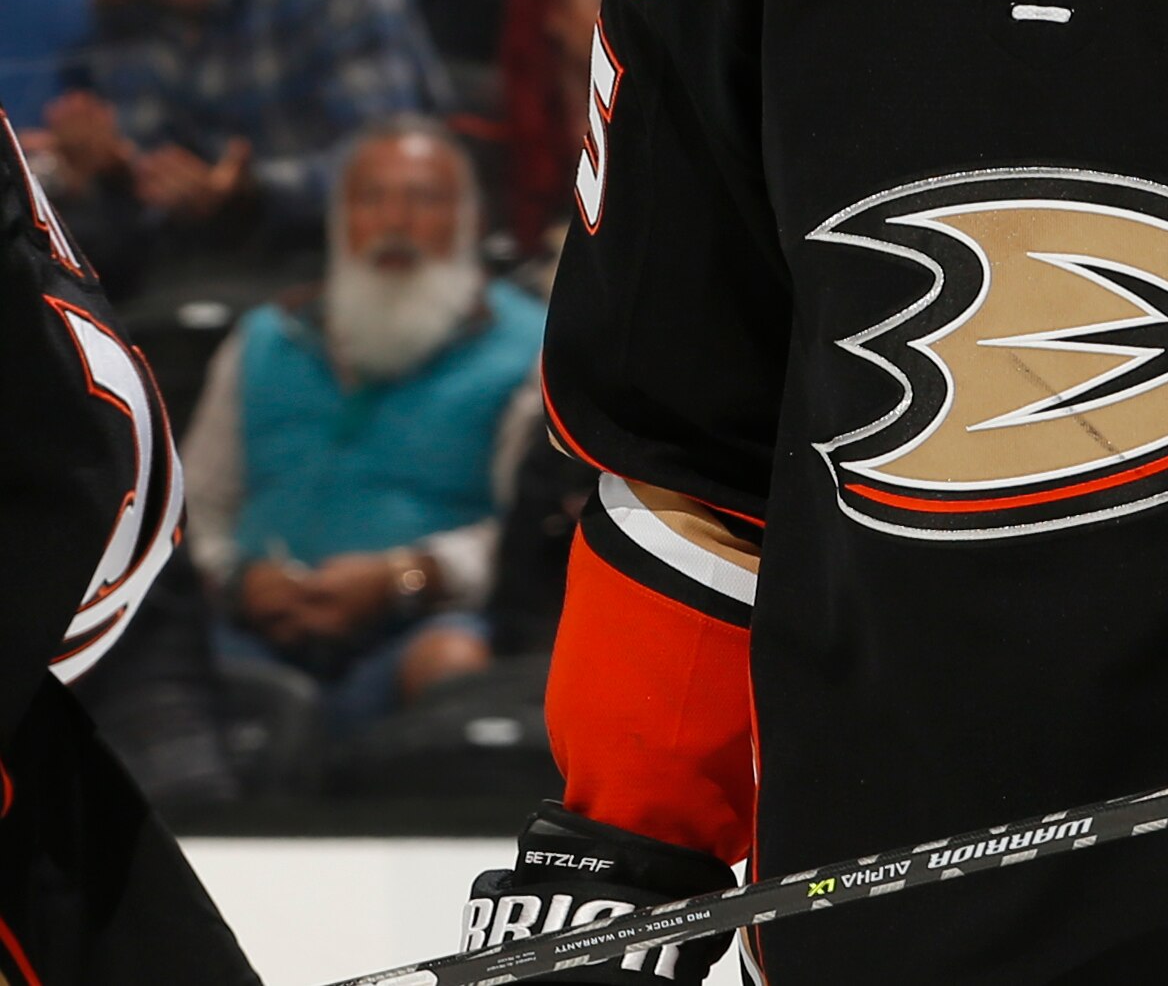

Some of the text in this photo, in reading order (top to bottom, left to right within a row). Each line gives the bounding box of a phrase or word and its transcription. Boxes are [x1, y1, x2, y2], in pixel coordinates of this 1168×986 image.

[525, 851, 615, 873] GETZLAF
[807, 817, 1093, 898] WARRIOR ALPHA LX
[645, 916, 683, 932] STOCK
[687, 910, 711, 923] PRO
[618, 928, 636, 939] NO
[554, 933, 616, 954] WARRANTY
